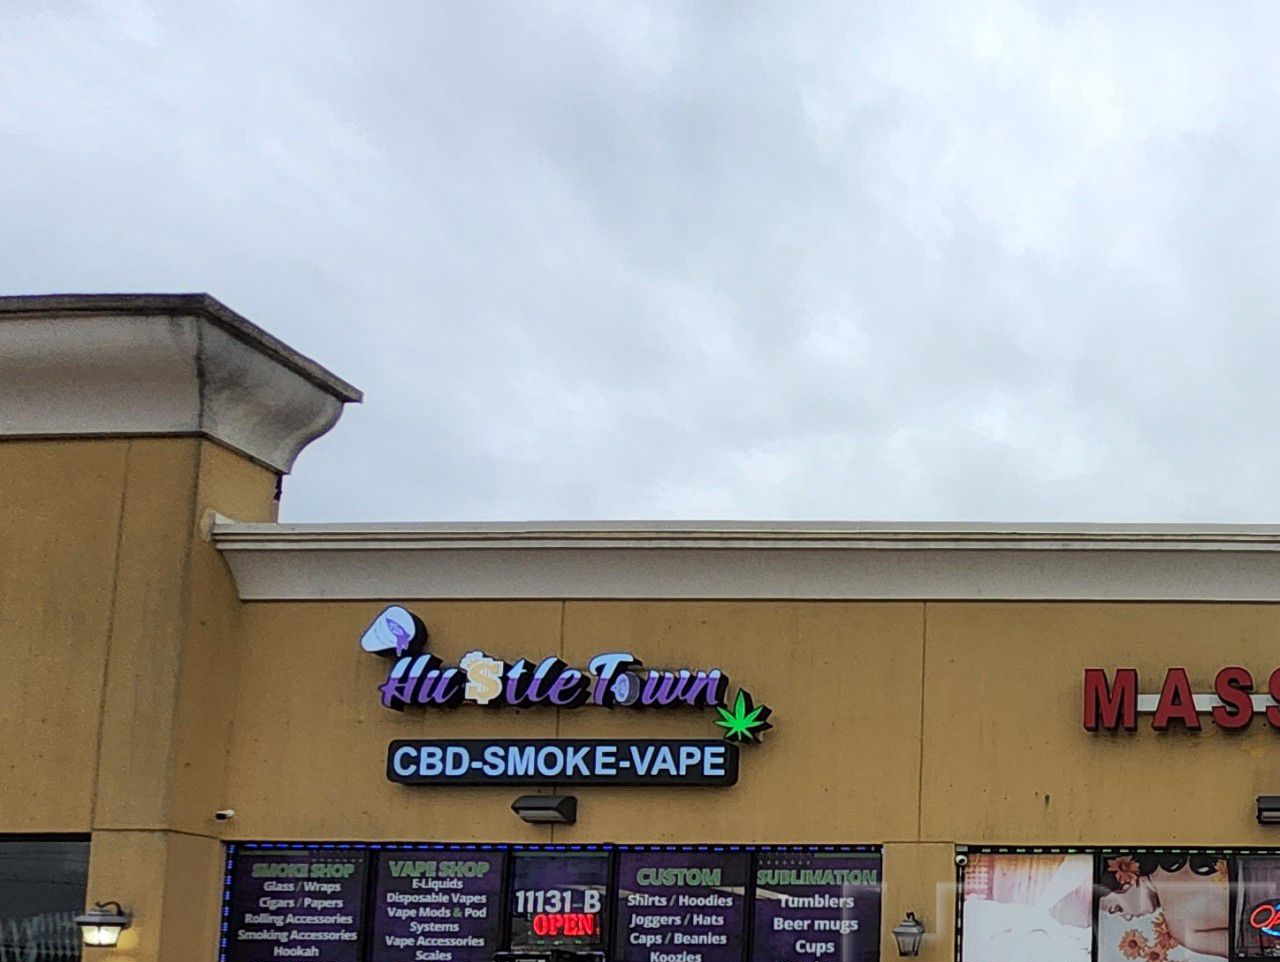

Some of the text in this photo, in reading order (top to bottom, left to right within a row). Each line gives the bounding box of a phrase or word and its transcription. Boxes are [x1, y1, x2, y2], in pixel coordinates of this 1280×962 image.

[393, 745, 726, 777] CBD-SMOKE-VAPE
[310, 863, 355, 878] SHOP
[388, 860, 490, 878] VAPE SHOP
[636, 868, 722, 886] CUSTOM
[756, 869, 877, 886] SUBLIMATION
[263, 881, 295, 892] Glass
[303, 881, 341, 895] Wraps
[411, 878, 464, 891] E-Liquids
[259, 897, 295, 910] Cigars
[303, 897, 344, 911] Papers
[386, 892, 487, 906] Disposable Vapes
[627, 894, 667, 906] Shirts
[678, 894, 733, 906] Hoodies
[780, 894, 855, 908] Tumblers
[244, 913, 353, 926] Rolling Accessories
[387, 907, 417, 920] Vape
[419, 907, 451, 917] Mods
[464, 907, 487, 918] Pod
[629, 913, 681, 928] Joggers
[693, 914, 724, 926] Hats
[409, 921, 460, 934] Systems
[533, 913, 595, 936] OPEN
[773, 917, 859, 935] Beer mugs
[237, 929, 358, 942] Smoking Accessories
[385, 935, 485, 949] Vape Accessories
[629, 932, 663, 948] Caps
[673, 932, 727, 945] Beanies
[273, 946, 319, 956] Hookah
[415, 950, 452, 960] Scales
[795, 939, 835, 957] Cups
[650, 951, 702, 962] Koozies
